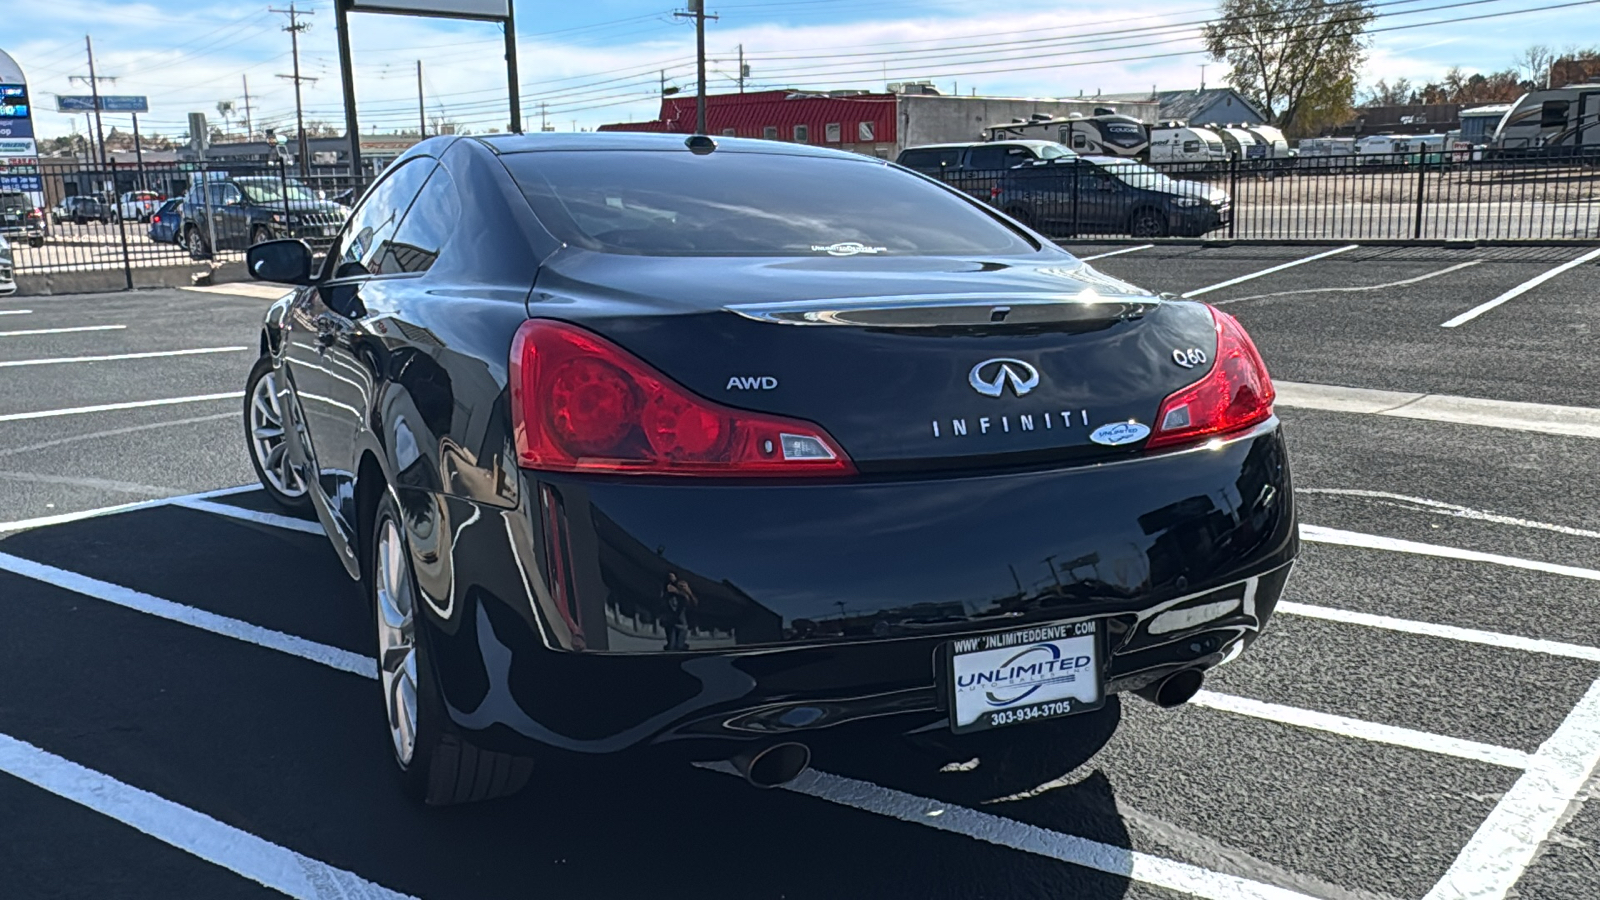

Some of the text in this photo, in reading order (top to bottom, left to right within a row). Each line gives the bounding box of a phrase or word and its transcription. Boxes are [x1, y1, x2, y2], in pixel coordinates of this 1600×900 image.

[1172, 348, 1207, 369] Q60
[726, 376, 778, 390] AWD
[932, 409, 1089, 437] INFINITI
[1098, 427, 1138, 437] UNLIMITED
[957, 655, 1091, 688] UNLIMITED
[957, 682, 998, 693] AUTO
[1009, 672, 1056, 685] SALES
[991, 701, 1071, 726] 303-934-3705
